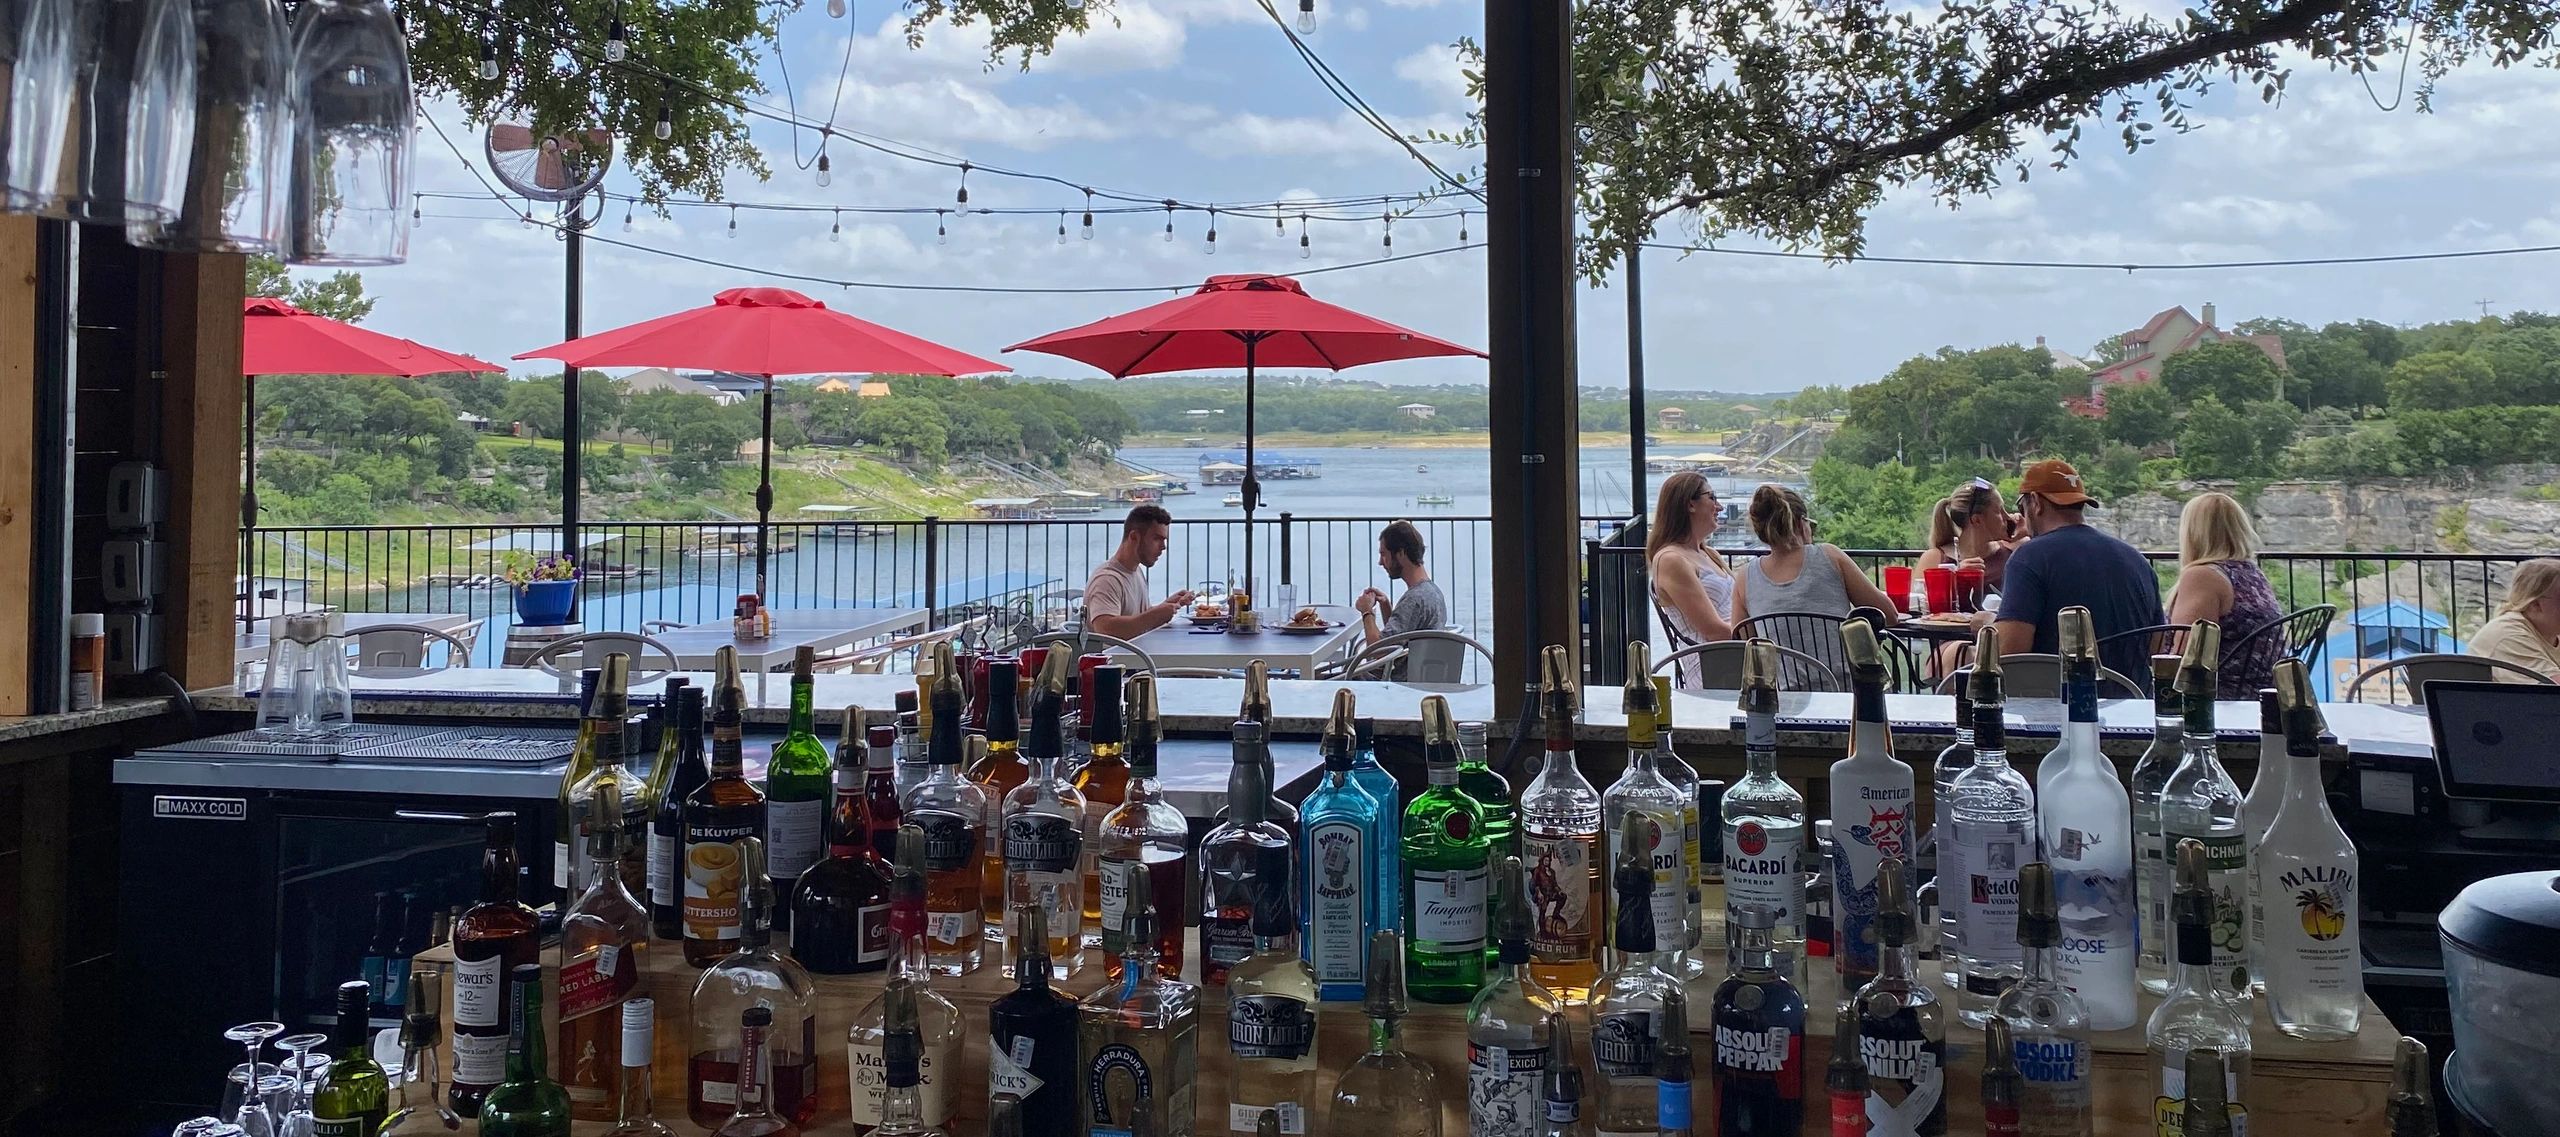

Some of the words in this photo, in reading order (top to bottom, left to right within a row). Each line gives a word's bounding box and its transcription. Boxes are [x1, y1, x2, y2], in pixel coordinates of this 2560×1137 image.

[1860, 786, 1910, 800] American
[170, 801, 206, 813] MAXX
[209, 803, 242, 814] COLD
[690, 827, 703, 837] DE
[704, 826, 753, 837] KUYPER
[1318, 832, 1355, 850] BOMBAY
[1006, 842, 1033, 859] IRON
[1726, 856, 1786, 875] BACARDÍ
[1733, 876, 1775, 887] SUPERIOR
[2279, 865, 2356, 893] MALIBU
[1316, 883, 1357, 900] SAPPHIRE
[1973, 878, 2008, 899] Ketel
[1424, 900, 1485, 920] Tanqueray
[1556, 945, 1578, 955] RUM
[2062, 936, 2107, 954] OOSE
[458, 971, 494, 985] ewar's
[560, 981, 579, 995] RED
[582, 972, 609, 988] LABE
[463, 990, 473, 1002] 12
[1231, 1020, 1264, 1045] IRON
[1599, 1039, 1634, 1063] IRON
[2015, 1040, 2076, 1063] BSOLU
[1094, 1050, 1146, 1077] HERRADURA
[1509, 1058, 1537, 1069] EXICO
